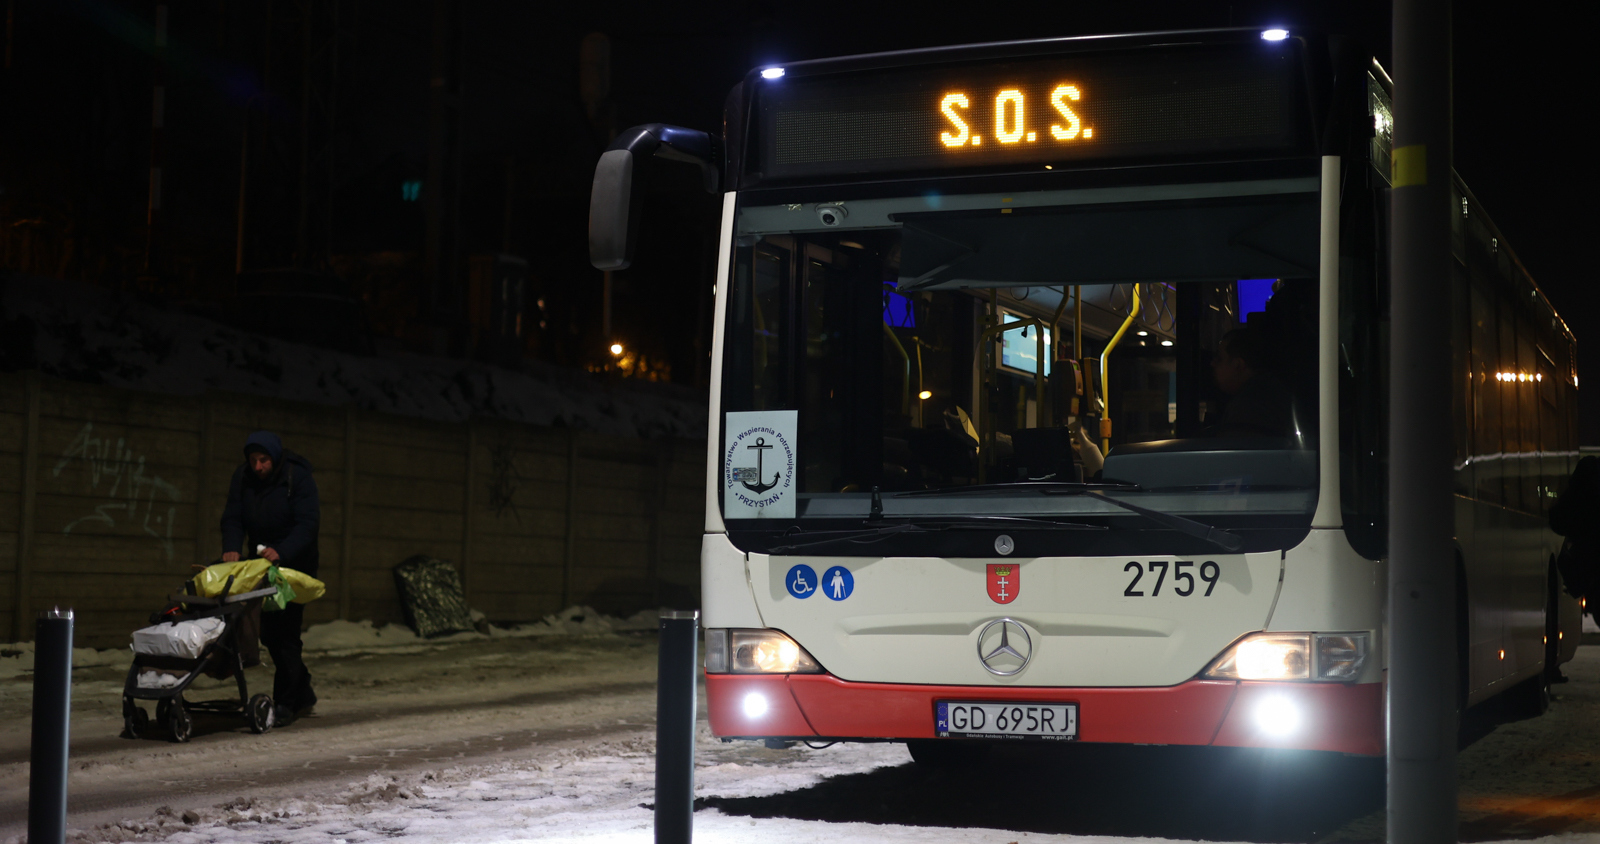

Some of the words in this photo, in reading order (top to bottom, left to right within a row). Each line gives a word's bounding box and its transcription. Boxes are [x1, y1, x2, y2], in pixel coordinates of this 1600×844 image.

[725, 441, 738, 489] Towarzystwo
[737, 427, 775, 440] Wspierania
[776, 432, 794, 488] Potrzebujących
[738, 492, 780, 508] PRZYSTAŃ
[1123, 560, 1221, 597] 2759
[938, 720, 948, 728] PL
[952, 706, 986, 731] GD
[996, 706, 1069, 733] 695RJ
